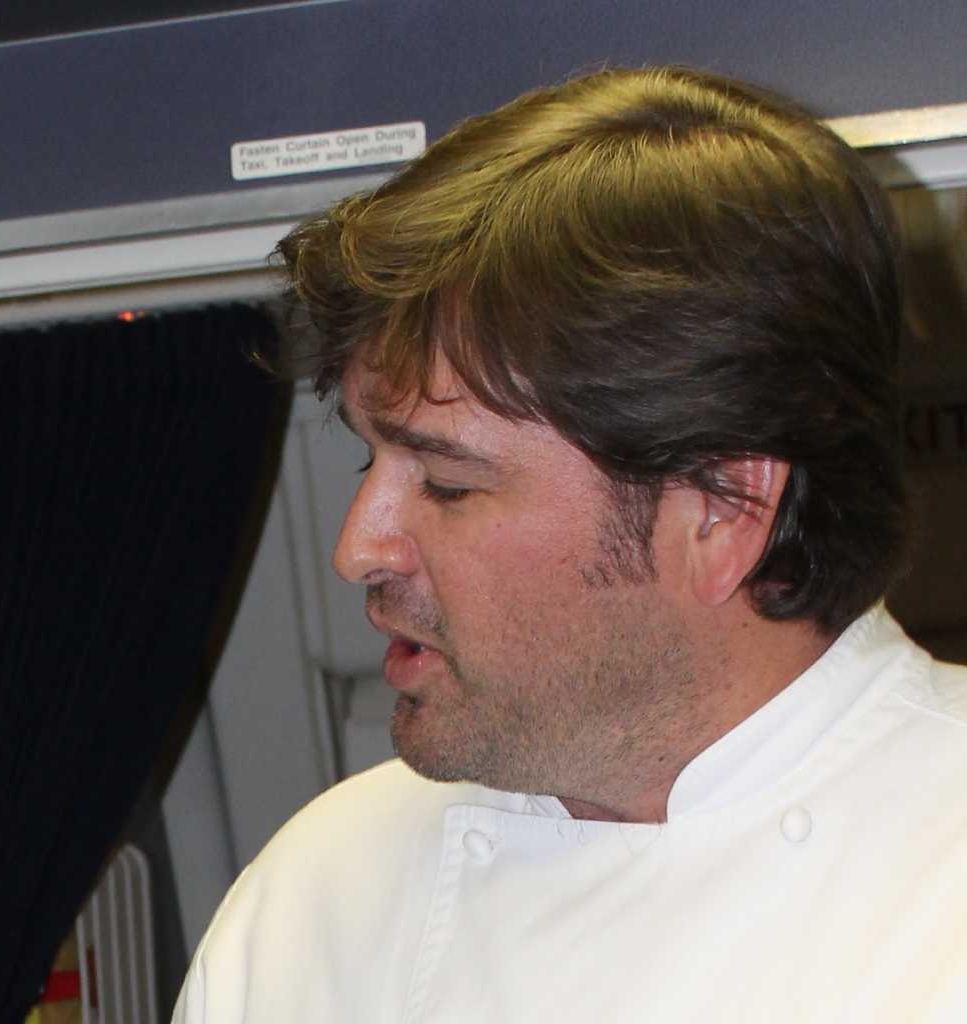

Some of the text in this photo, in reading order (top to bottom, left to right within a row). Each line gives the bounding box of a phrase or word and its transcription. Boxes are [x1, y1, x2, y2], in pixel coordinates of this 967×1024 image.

[239, 126, 417, 157] Fasten Curtain Open During
[275, 153, 319, 168] Takeoff
[325, 149, 347, 162] and
[354, 143, 404, 159] Landing
